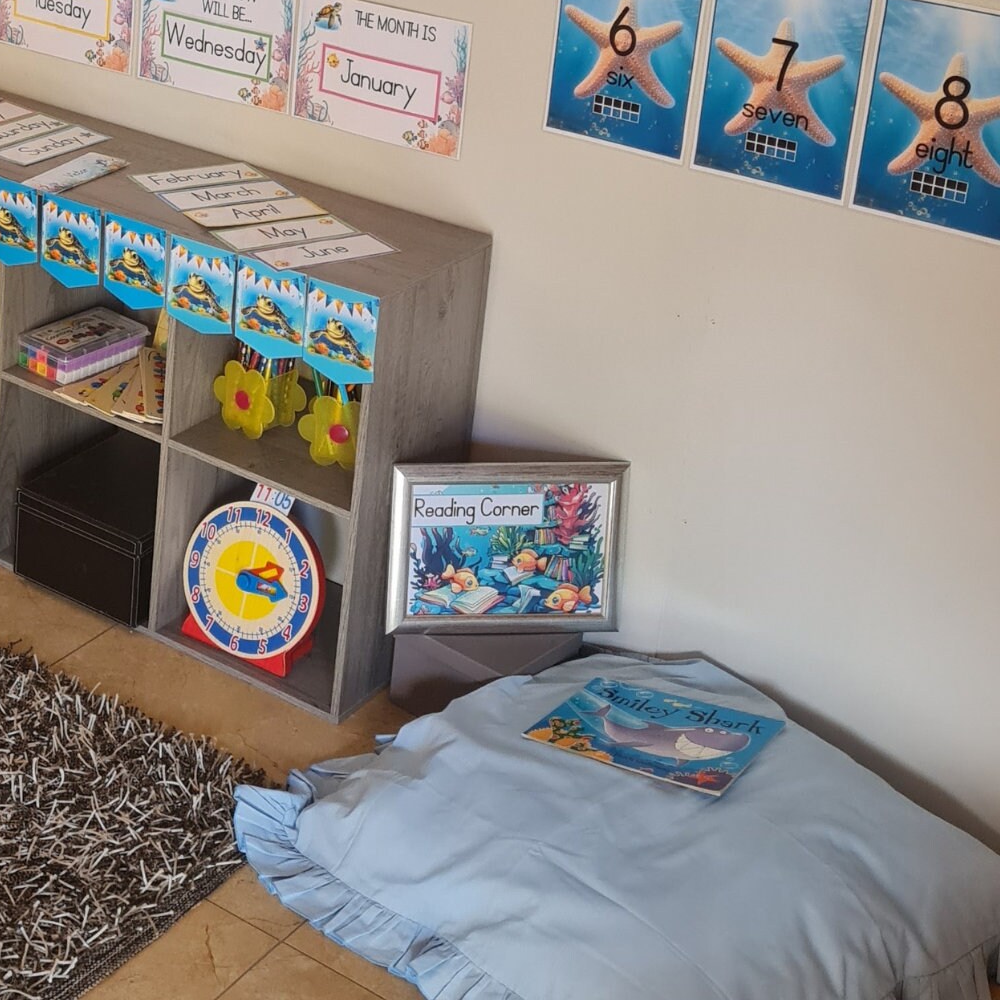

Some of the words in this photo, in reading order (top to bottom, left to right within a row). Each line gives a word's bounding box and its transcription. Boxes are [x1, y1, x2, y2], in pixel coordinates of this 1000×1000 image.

[355, 9, 374, 28] THE
[377, 15, 419, 38] MONTH
[422, 24, 437, 42] IS
[609, 5, 636, 57] 6
[165, 18, 268, 75] Wednesday
[771, 37, 799, 91] 7
[340, 58, 417, 110] January
[606, 66, 635, 89] six
[934, 75, 971, 130] 8
[742, 101, 809, 131] seven
[17, 135, 84, 156] Sunday
[915, 137, 974, 175] eight
[147, 168, 243, 186] February
[190, 186, 262, 202] March
[231, 203, 282, 221] April
[257, 226, 310, 239] May
[297, 243, 349, 260] June
[256, 484, 292, 510] 11:05
[227, 506, 241, 523] 11
[256, 508, 271, 527] 12
[414, 497, 475, 525] Reading
[480, 497, 539, 518] Corner
[201, 522, 216, 540] 10
[285, 528, 292, 544] 1
[190, 552, 199, 567] 9
[300, 561, 309, 578] 2
[192, 587, 200, 603] 8
[299, 596, 308, 612] 3
[206, 616, 214, 631] 7
[282, 625, 292, 641] 4
[230, 636, 239, 651] 6
[258, 639, 267, 654] 5
[599, 687, 679, 719] Smiley
[686, 709, 767, 735] Shark
